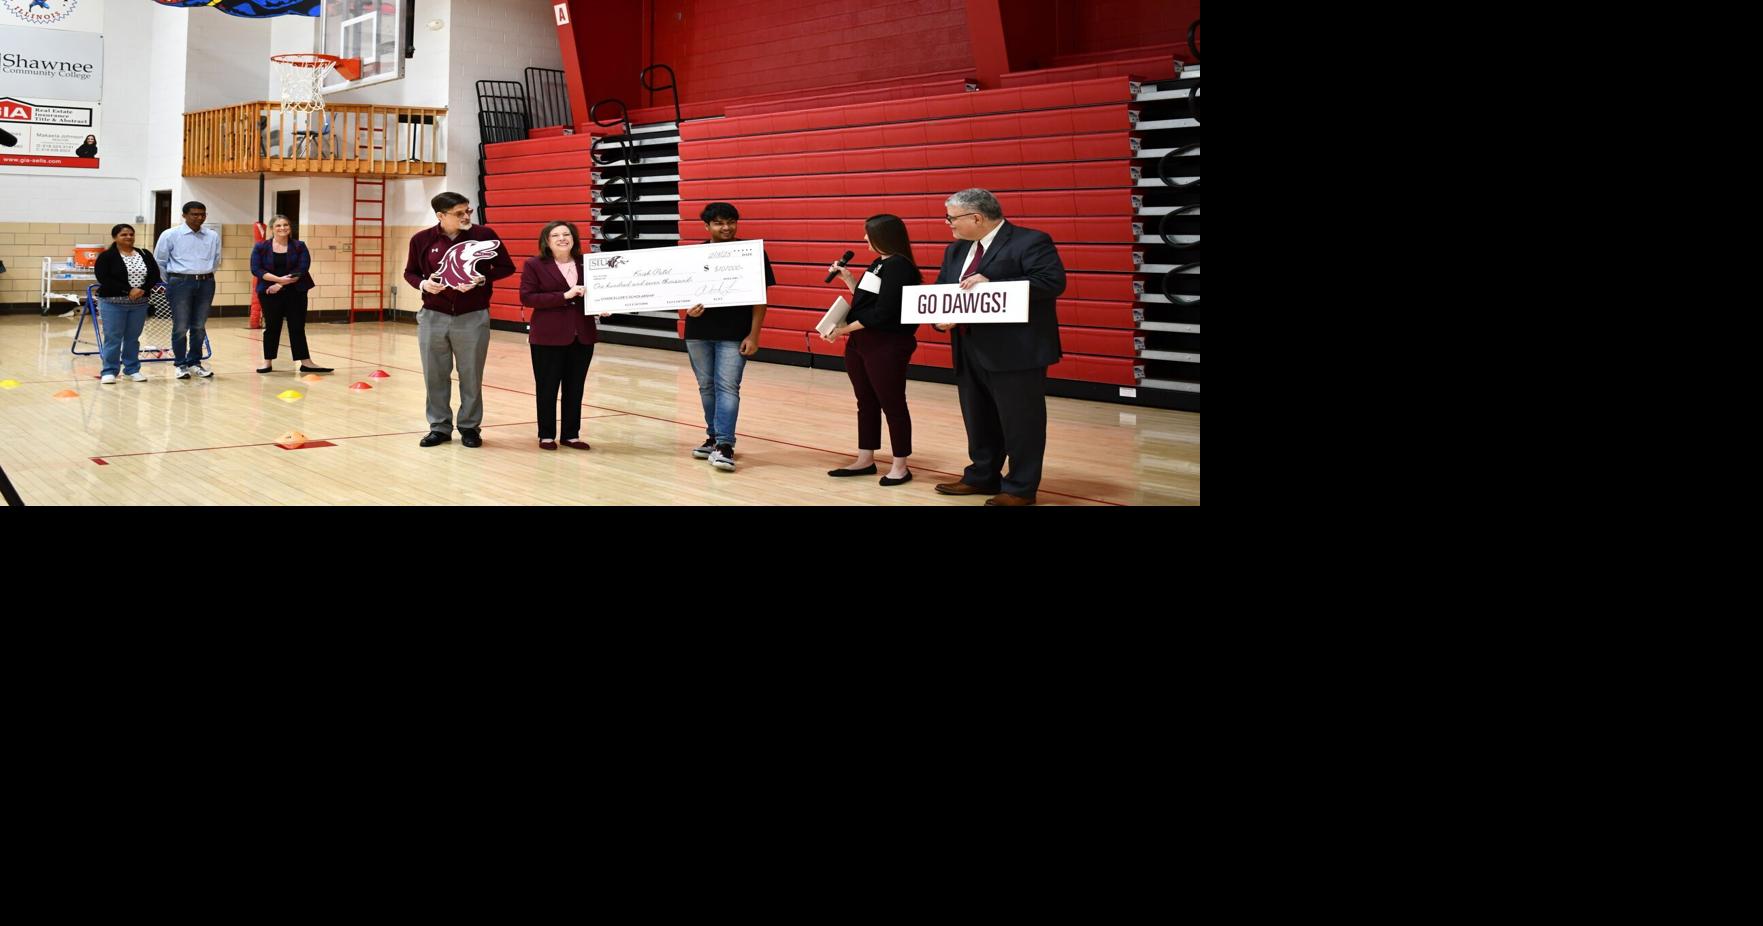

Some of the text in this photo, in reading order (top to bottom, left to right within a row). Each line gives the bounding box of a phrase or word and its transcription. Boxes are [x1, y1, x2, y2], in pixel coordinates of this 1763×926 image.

[14, 6, 61, 20] ILLINOIS
[558, 7, 566, 22] A
[3, 53, 94, 73] Shawnee
[2, 66, 92, 80] Community College
[0, 106, 29, 119] IA
[592, 257, 609, 267] SIU
[917, 291, 1007, 314] GO DAWGS!
